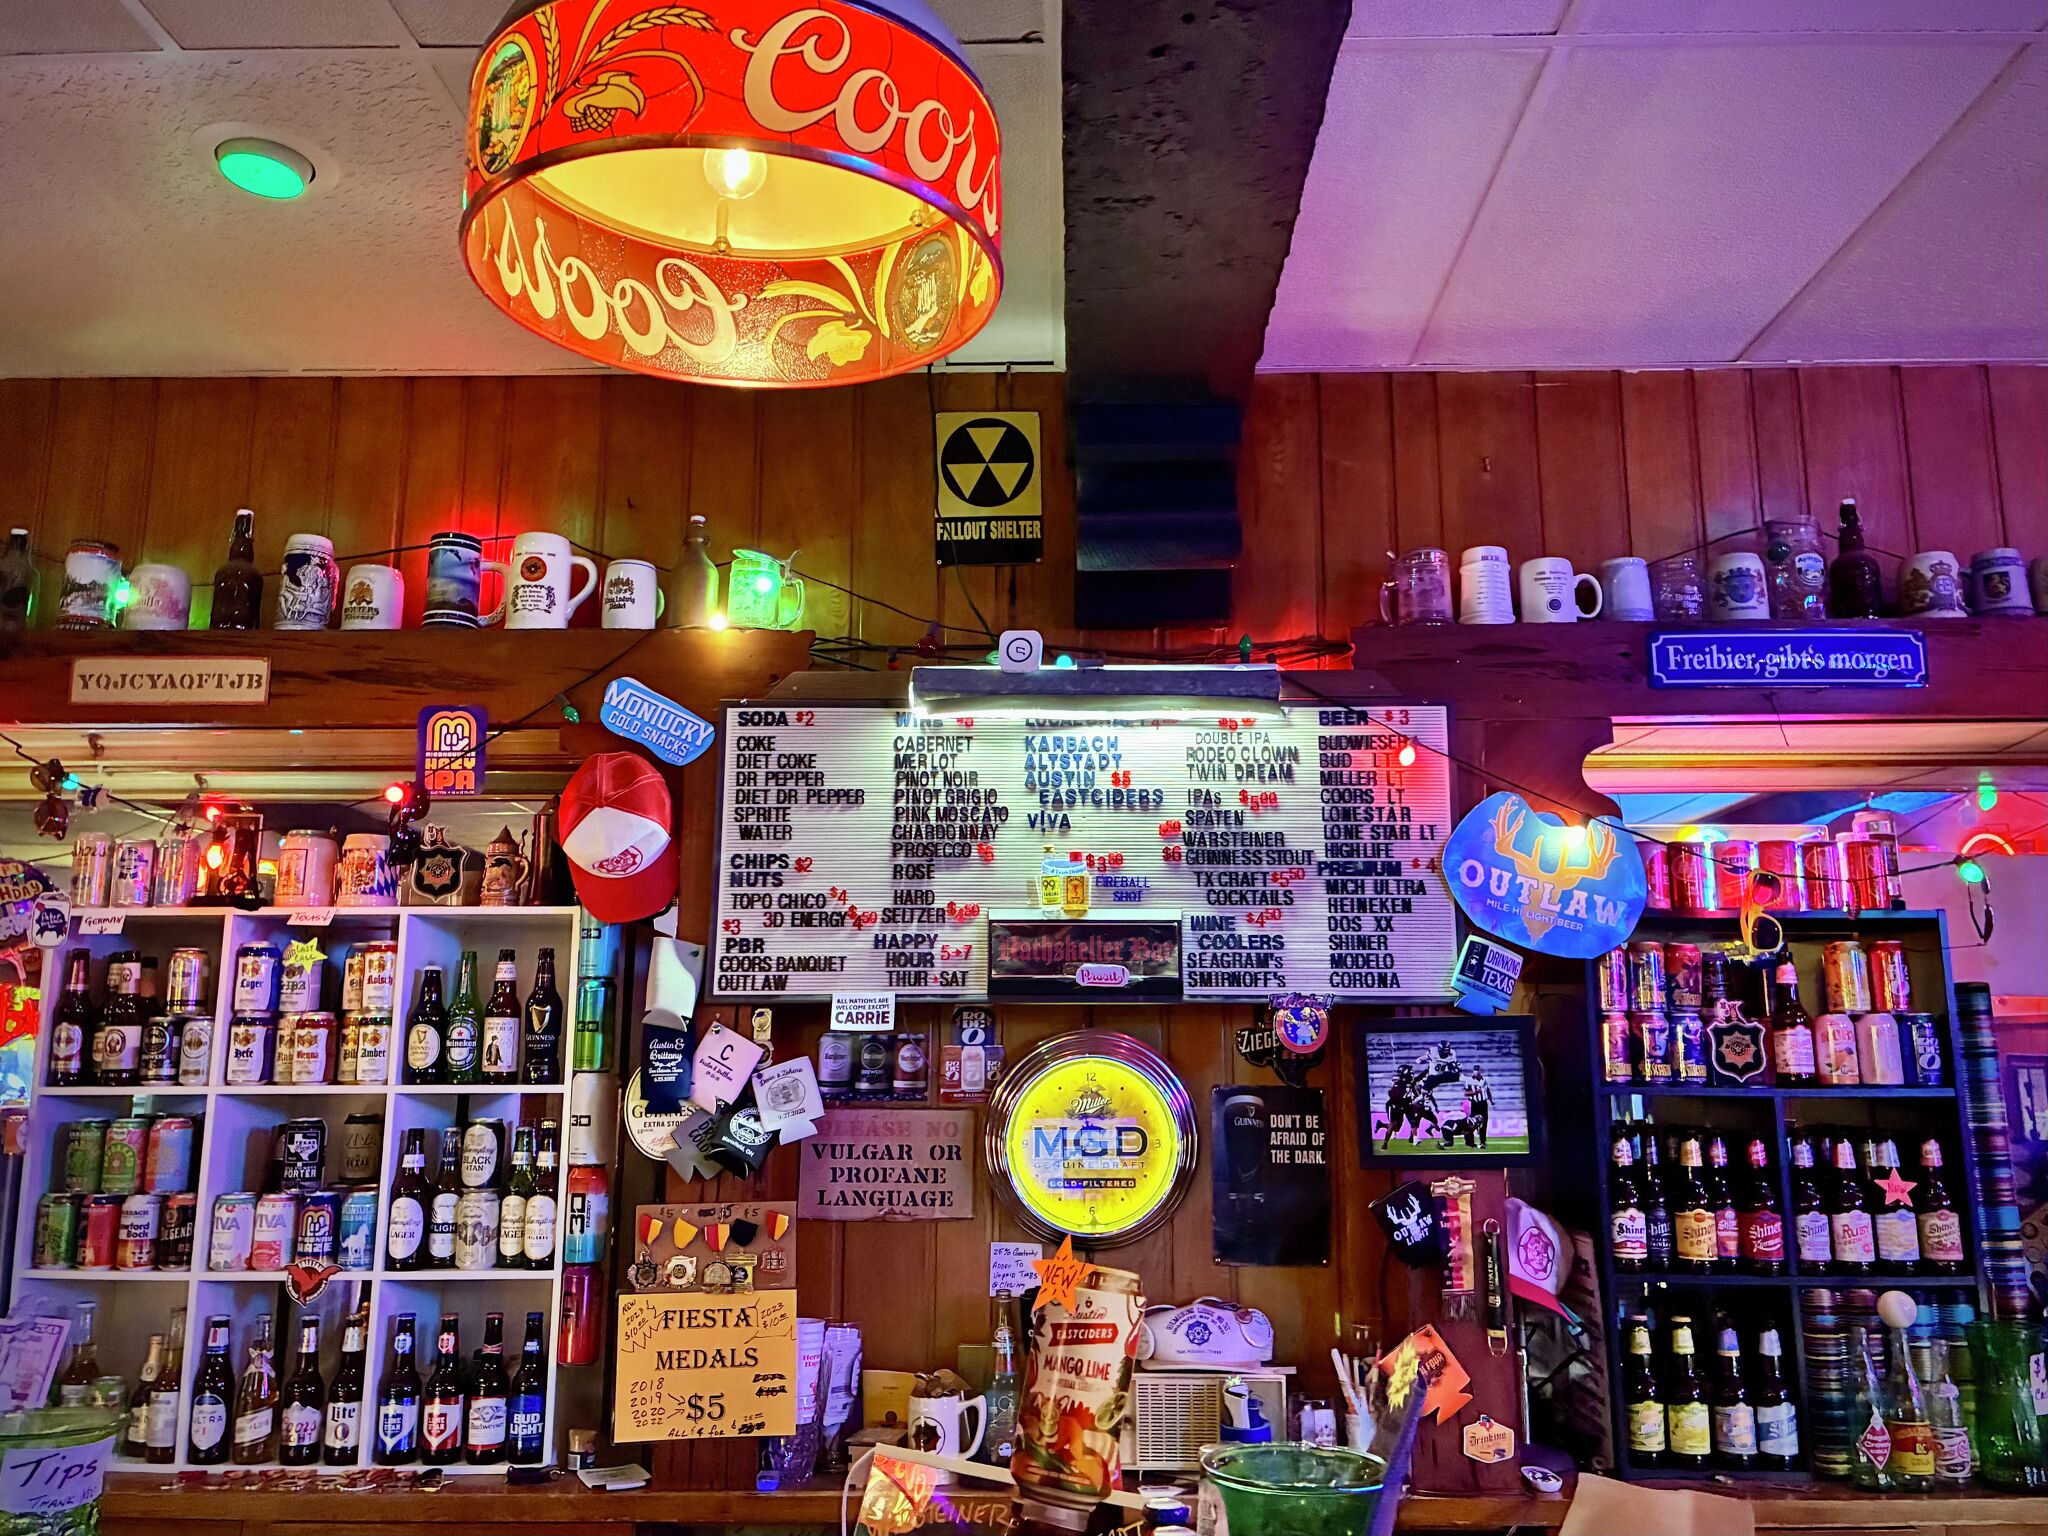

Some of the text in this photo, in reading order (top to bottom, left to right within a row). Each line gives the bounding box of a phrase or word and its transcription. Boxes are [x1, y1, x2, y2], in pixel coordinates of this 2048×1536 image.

[729, 8, 999, 236] Coors
[937, 521, 1041, 540] FALLOUT SHELTER
[1829, 651, 1914, 678] morgen
[604, 681, 715, 747] MONTUCKY
[737, 711, 815, 727] SODA $2
[1318, 710, 1369, 726] BEER
[608, 710, 688, 756] COLD SNACKS
[1195, 732, 1243, 745] DOUBLE
[736, 736, 776, 752] COKE
[894, 736, 973, 753] CABERNET
[1025, 736, 1118, 752] KARBACH
[1318, 735, 1408, 750] BUDWIESER
[736, 753, 817, 769] DIET COKE
[894, 753, 958, 769] MERLOT
[1024, 753, 1122, 770] ALTSTADT
[1186, 746, 1300, 763] RODEO CLOWN
[1319, 753, 1352, 768] BUD
[425, 758, 475, 770] HAZY
[425, 771, 475, 790] IPA
[735, 771, 824, 787] DR PEPPER
[895, 771, 978, 787] PINOT NOIR
[1024, 771, 1131, 788] AUSTIN $5
[1186, 764, 1294, 782] TWIN DREAM
[1320, 771, 1377, 786] MILLER
[735, 789, 865, 805] DIET PEPPER
[895, 789, 942, 805] PINOT
[1039, 789, 1163, 805] EASTCIDERS
[1320, 789, 1374, 804] COORS
[734, 807, 791, 822] SPRITE
[895, 806, 1008, 822] PINK MOSCATO
[1185, 810, 1244, 826] SPATEN
[739, 824, 792, 840] WATER
[892, 824, 998, 840] CHARDONNAY
[1182, 831, 1285, 847] WARSTEINER
[1324, 825, 1410, 840] LONE STAR
[892, 842, 972, 858] PROSECCO
[1185, 849, 1314, 865] GUINNESS STOUT
[730, 853, 813, 873] CHIPS $2
[1317, 861, 1401, 877] PREMIUM
[729, 872, 784, 887] NUTS
[1218, 871, 1270, 887] CRAFT
[1325, 879, 1427, 895] MICH ULTRA
[894, 889, 935, 905] HARD
[1113, 891, 1143, 902] SHOT
[1206, 889, 1294, 905] COCKTAILS
[1459, 859, 1627, 926] OUTLAW
[731, 893, 826, 909] TOPO CHICO
[1329, 898, 1412, 913] HEINEKEN
[791, 911, 848, 927] ENERGY
[882, 907, 946, 924] SELTZER
[1190, 915, 1235, 931] WINE
[1486, 899, 1583, 932] MILE HI LIGHT BEER
[722, 919, 741, 935] $3
[1328, 916, 1362, 932] DOS
[725, 937, 765, 953] PBR
[874, 933, 938, 949] HAPPY
[1197, 934, 1284, 950] COOLERS
[1329, 934, 1388, 951] SHINER
[997, 935, 1175, 965] Rathskeller Bar
[719, 956, 847, 972] COORS BANQUET
[885, 952, 935, 968] HOUR
[1330, 953, 1394, 969] MODELO
[1486, 949, 1521, 979] DRINKING
[240, 980, 263, 989] Lager
[718, 974, 788, 991] OUTLAW
[886, 971, 929, 987] THUR
[1329, 972, 1400, 988] CORONA
[1483, 967, 1515, 995] TEXAS
[446, 1039, 477, 1048] Heineken
[650, 1038, 685, 1050] Austin &
[234, 1049, 253, 1059] Hefe
[361, 1048, 387, 1058] Amber
[1086, 1073, 1097, 1082] 12
[1072, 1097, 1111, 1115] Miller
[926, 1121, 960, 1138] NO
[1270, 1115, 1319, 1129] DON'T BE
[1033, 1126, 1148, 1158] MGD
[1155, 1140, 1161, 1148] 3
[1270, 1132, 1325, 1146] AFRAID OF
[462, 1155, 491, 1165] BLACK
[811, 1144, 962, 1161] VULGAR OR
[1271, 1150, 1326, 1164] THE DARK.
[1033, 1161, 1147, 1169] GENUINE DRAFT
[283, 1169, 317, 1179] PORTER
[830, 1167, 947, 1184] PROFANE
[817, 1190, 954, 1207] LANGUAGE
[1089, 1207, 1095, 1215] 6
[391, 1230, 416, 1239] LAGER
[1393, 1213, 1433, 1242] OUTLAW
[1617, 1223, 1645, 1236] Shiner
[1406, 1228, 1430, 1246] LIGHT
[1043, 1263, 1086, 1290] NEW!
[760, 1302, 784, 1319] 2023
[663, 1308, 753, 1330] FIESTA
[1056, 1328, 1113, 1340] EASTCIDERS
[655, 1348, 758, 1371] MEDALS
[1044, 1355, 1110, 1381] MANGO LIME
[630, 1378, 665, 1394] 2018
[630, 1392, 662, 1407] 2019
[330, 1405, 356, 1423] Lite
[632, 1408, 665, 1419] 2020
[686, 1392, 725, 1424] $5
[512, 1412, 541, 1424] BUD
[636, 1417, 663, 1427] 2022
[510, 1423, 545, 1435] LIGHT
[668, 1428, 688, 1437] ALL
[10, 1453, 98, 1489] Tips
